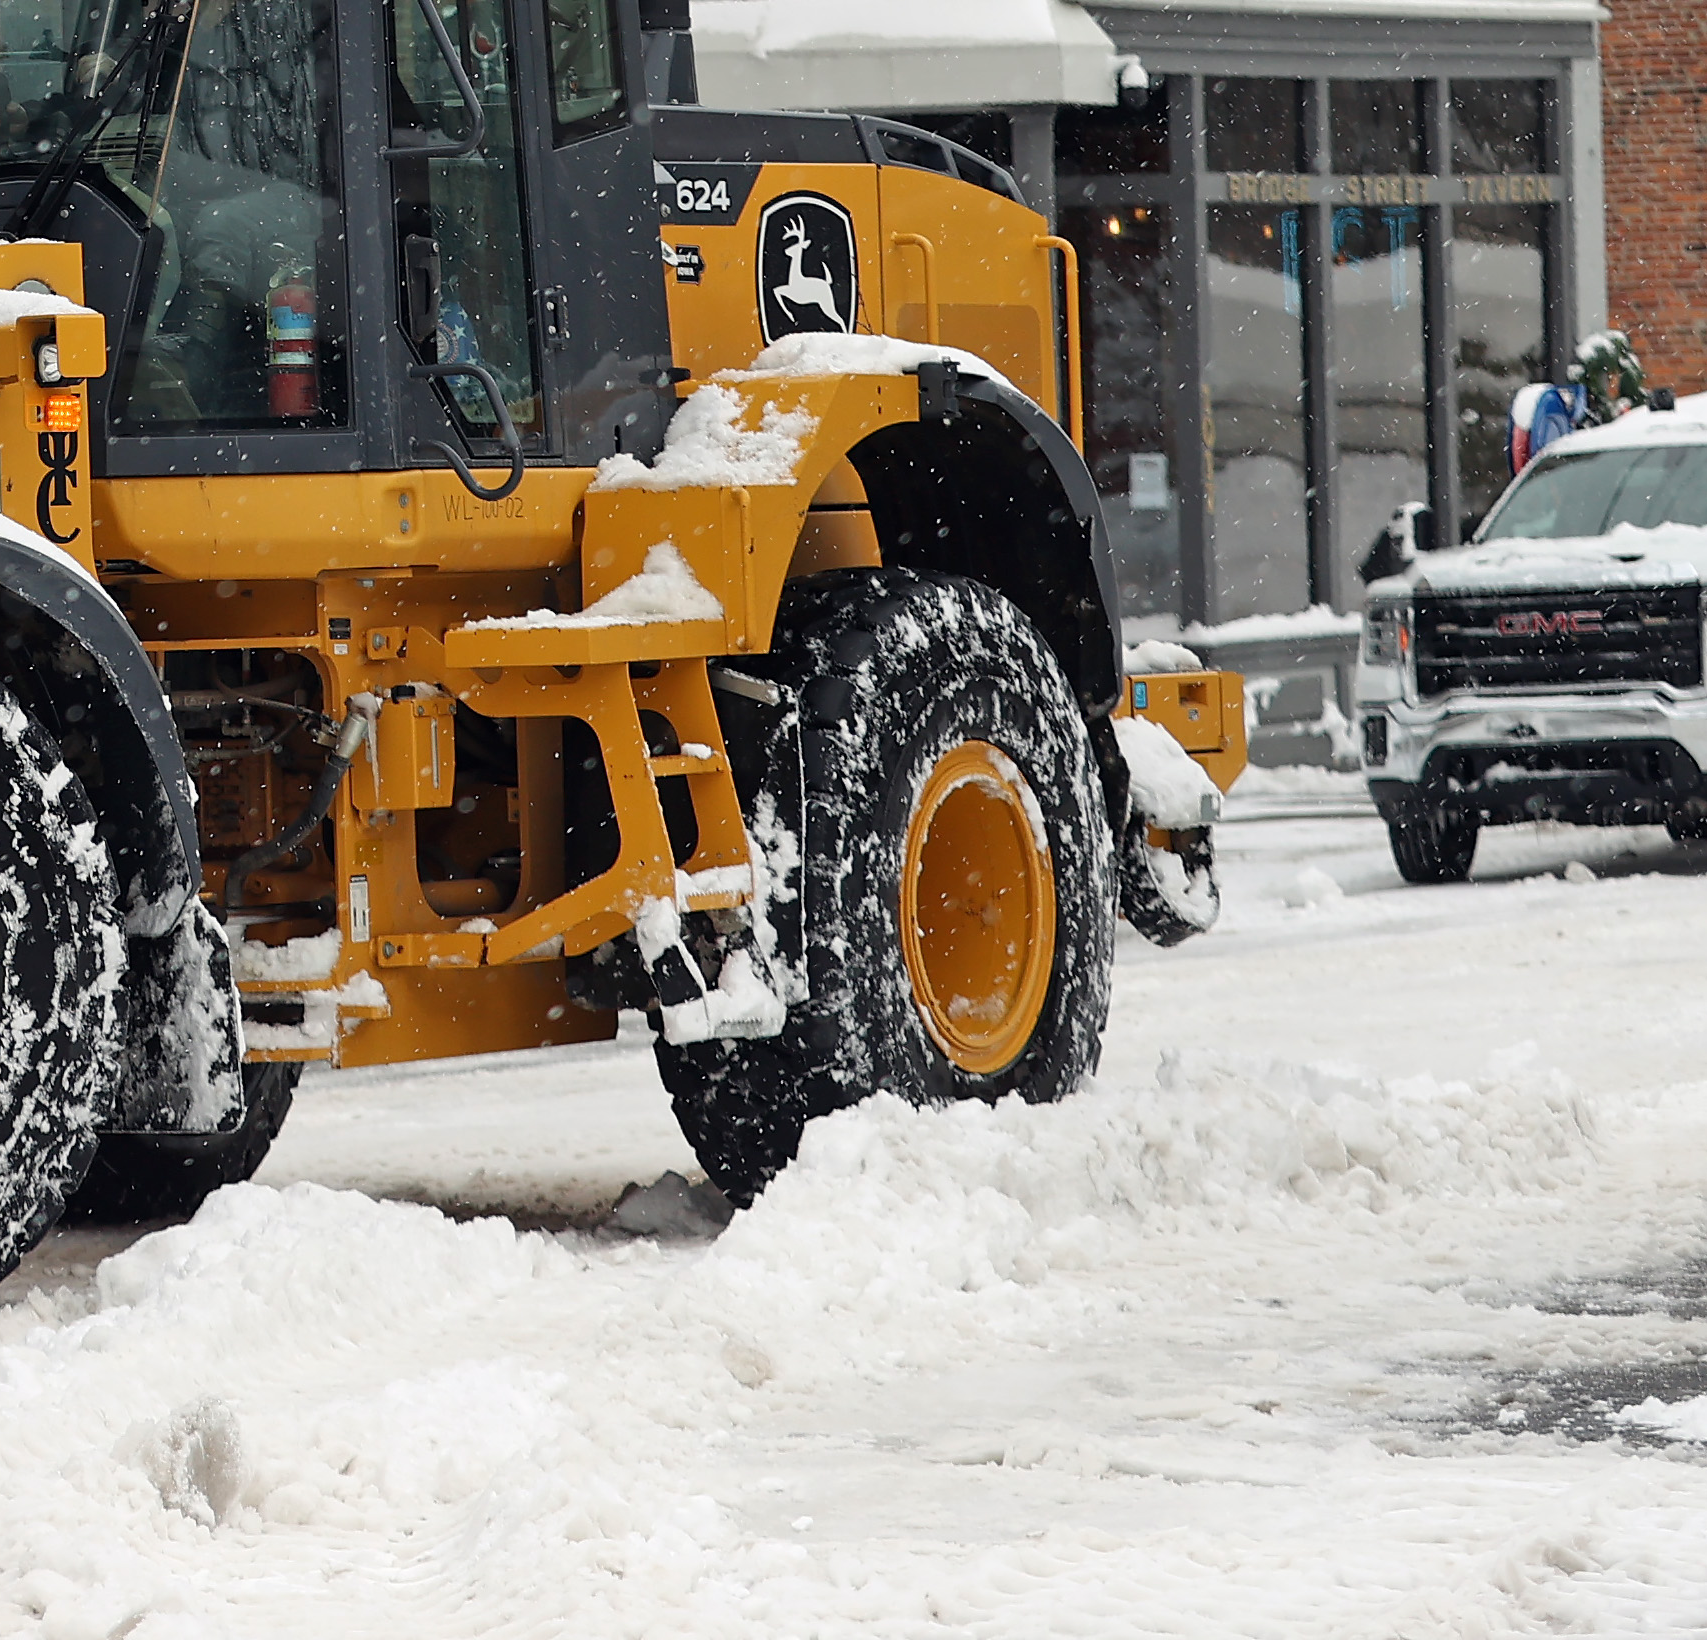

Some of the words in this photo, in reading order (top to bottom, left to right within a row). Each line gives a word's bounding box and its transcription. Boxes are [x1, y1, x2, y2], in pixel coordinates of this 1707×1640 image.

[676, 179, 731, 212] 624
[1228, 173, 1310, 203] BRIDGE
[1344, 174, 1430, 206] STREET
[1464, 176, 1552, 207] TAVERN
[1498, 609, 1603, 636] GMC
